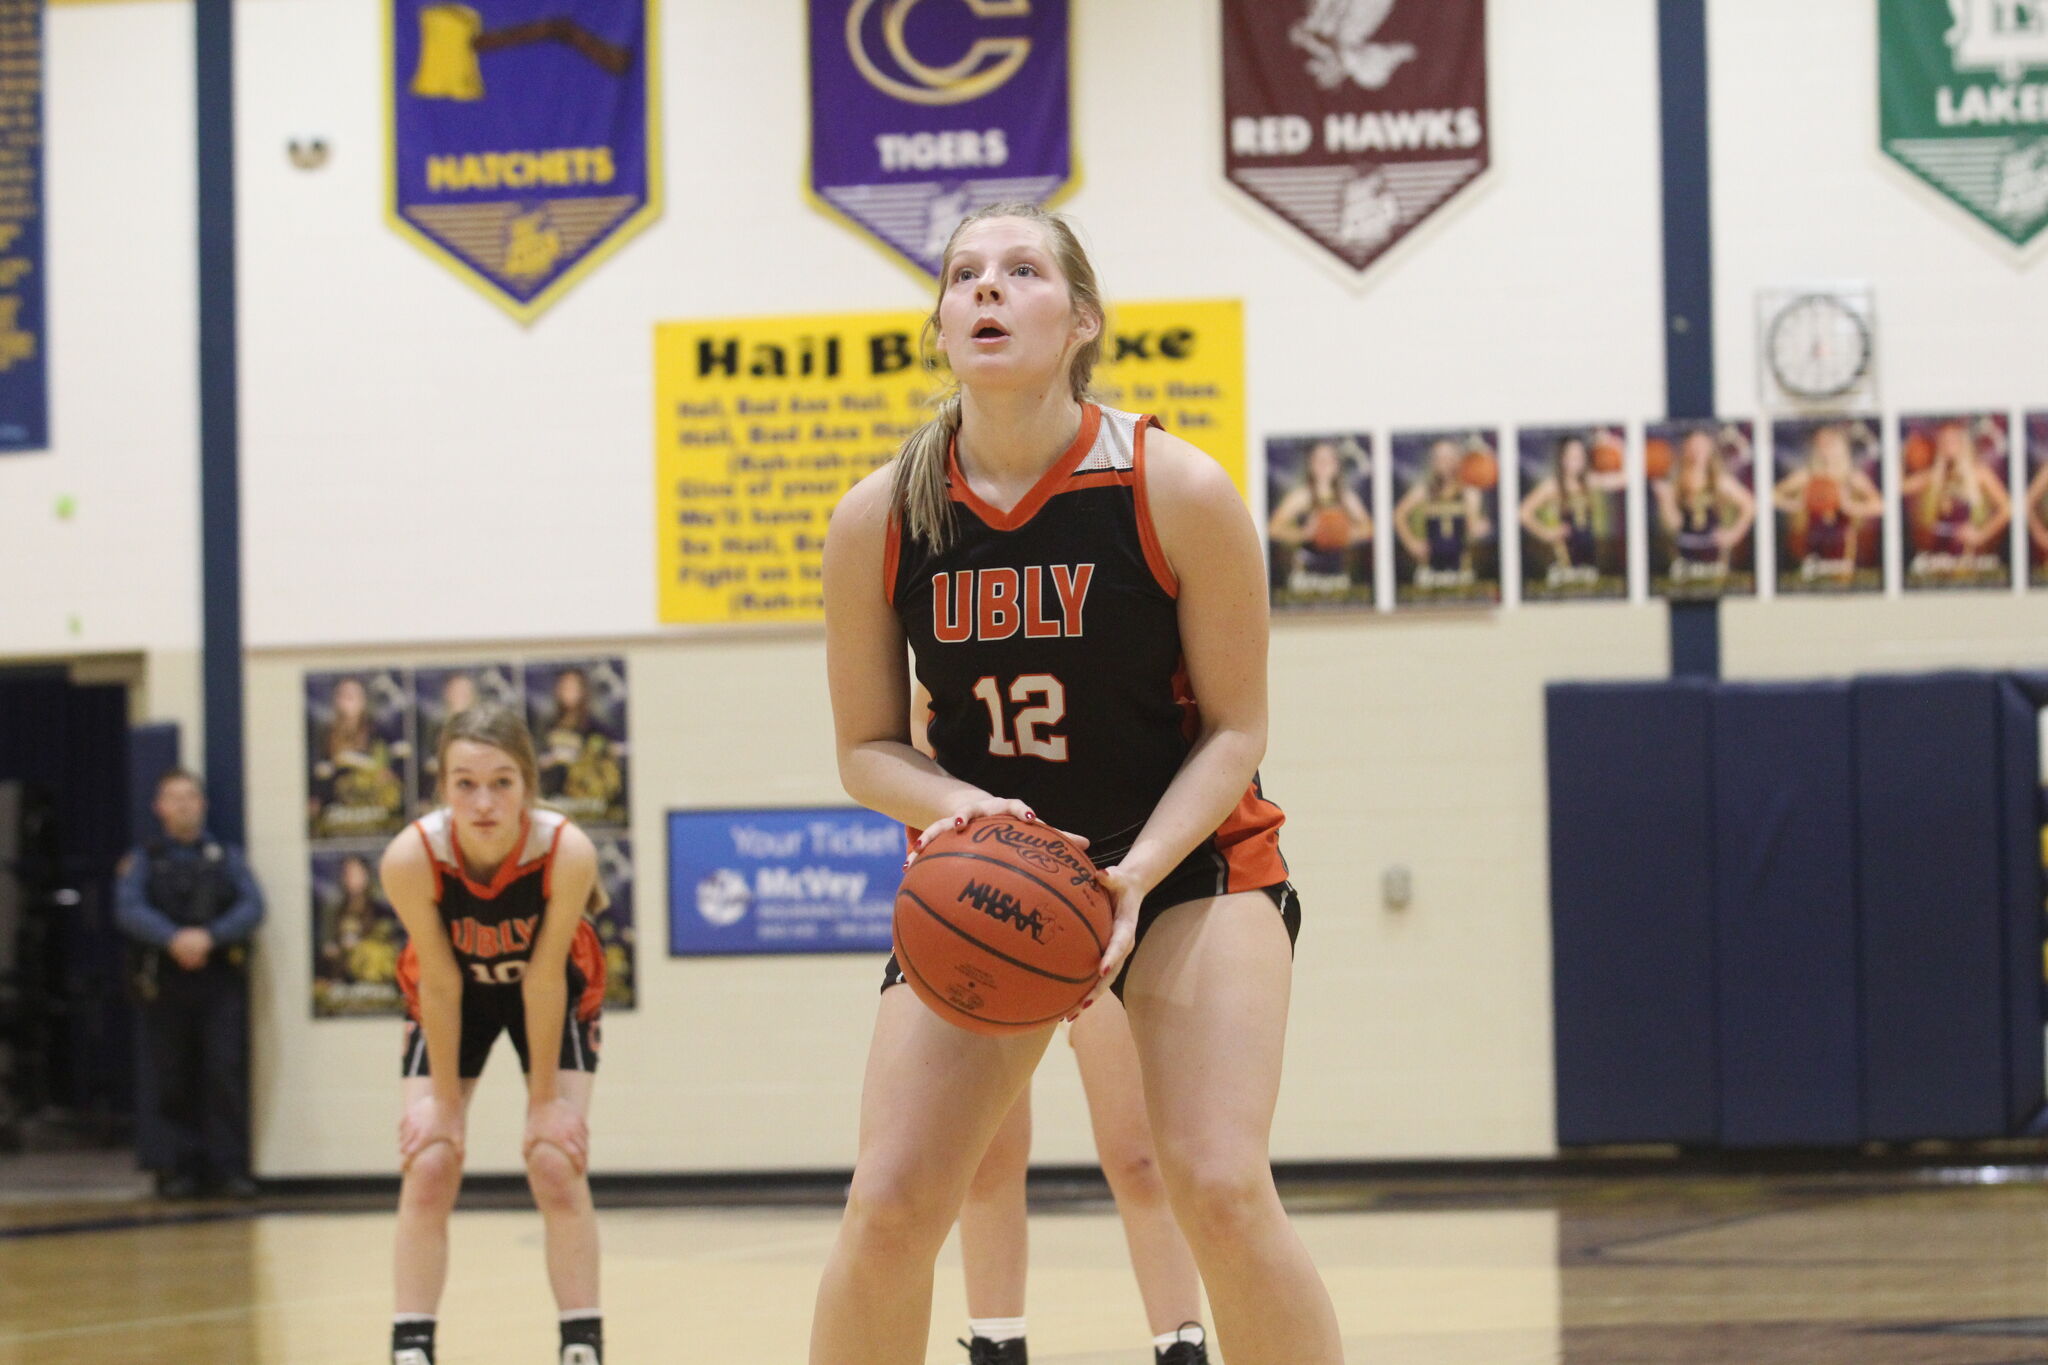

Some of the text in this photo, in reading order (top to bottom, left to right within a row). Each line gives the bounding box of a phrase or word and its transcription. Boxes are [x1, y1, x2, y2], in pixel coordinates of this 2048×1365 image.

[1936, 84, 2048, 126] LAKE
[875, 129, 1008, 171] TIGERS
[1232, 106, 1481, 155] RED HAWKS
[427, 147, 615, 191] HATCHETS
[697, 337, 840, 377] Hail
[1114, 326, 1195, 361] xe
[932, 563, 1095, 643] UBLY
[972, 673, 1069, 762] 12
[730, 824, 803, 858] Your
[972, 823, 1100, 892] Rawlings
[755, 866, 868, 902] McVey
[450, 914, 539, 957] UBLY
[469, 960, 529, 984] 10
